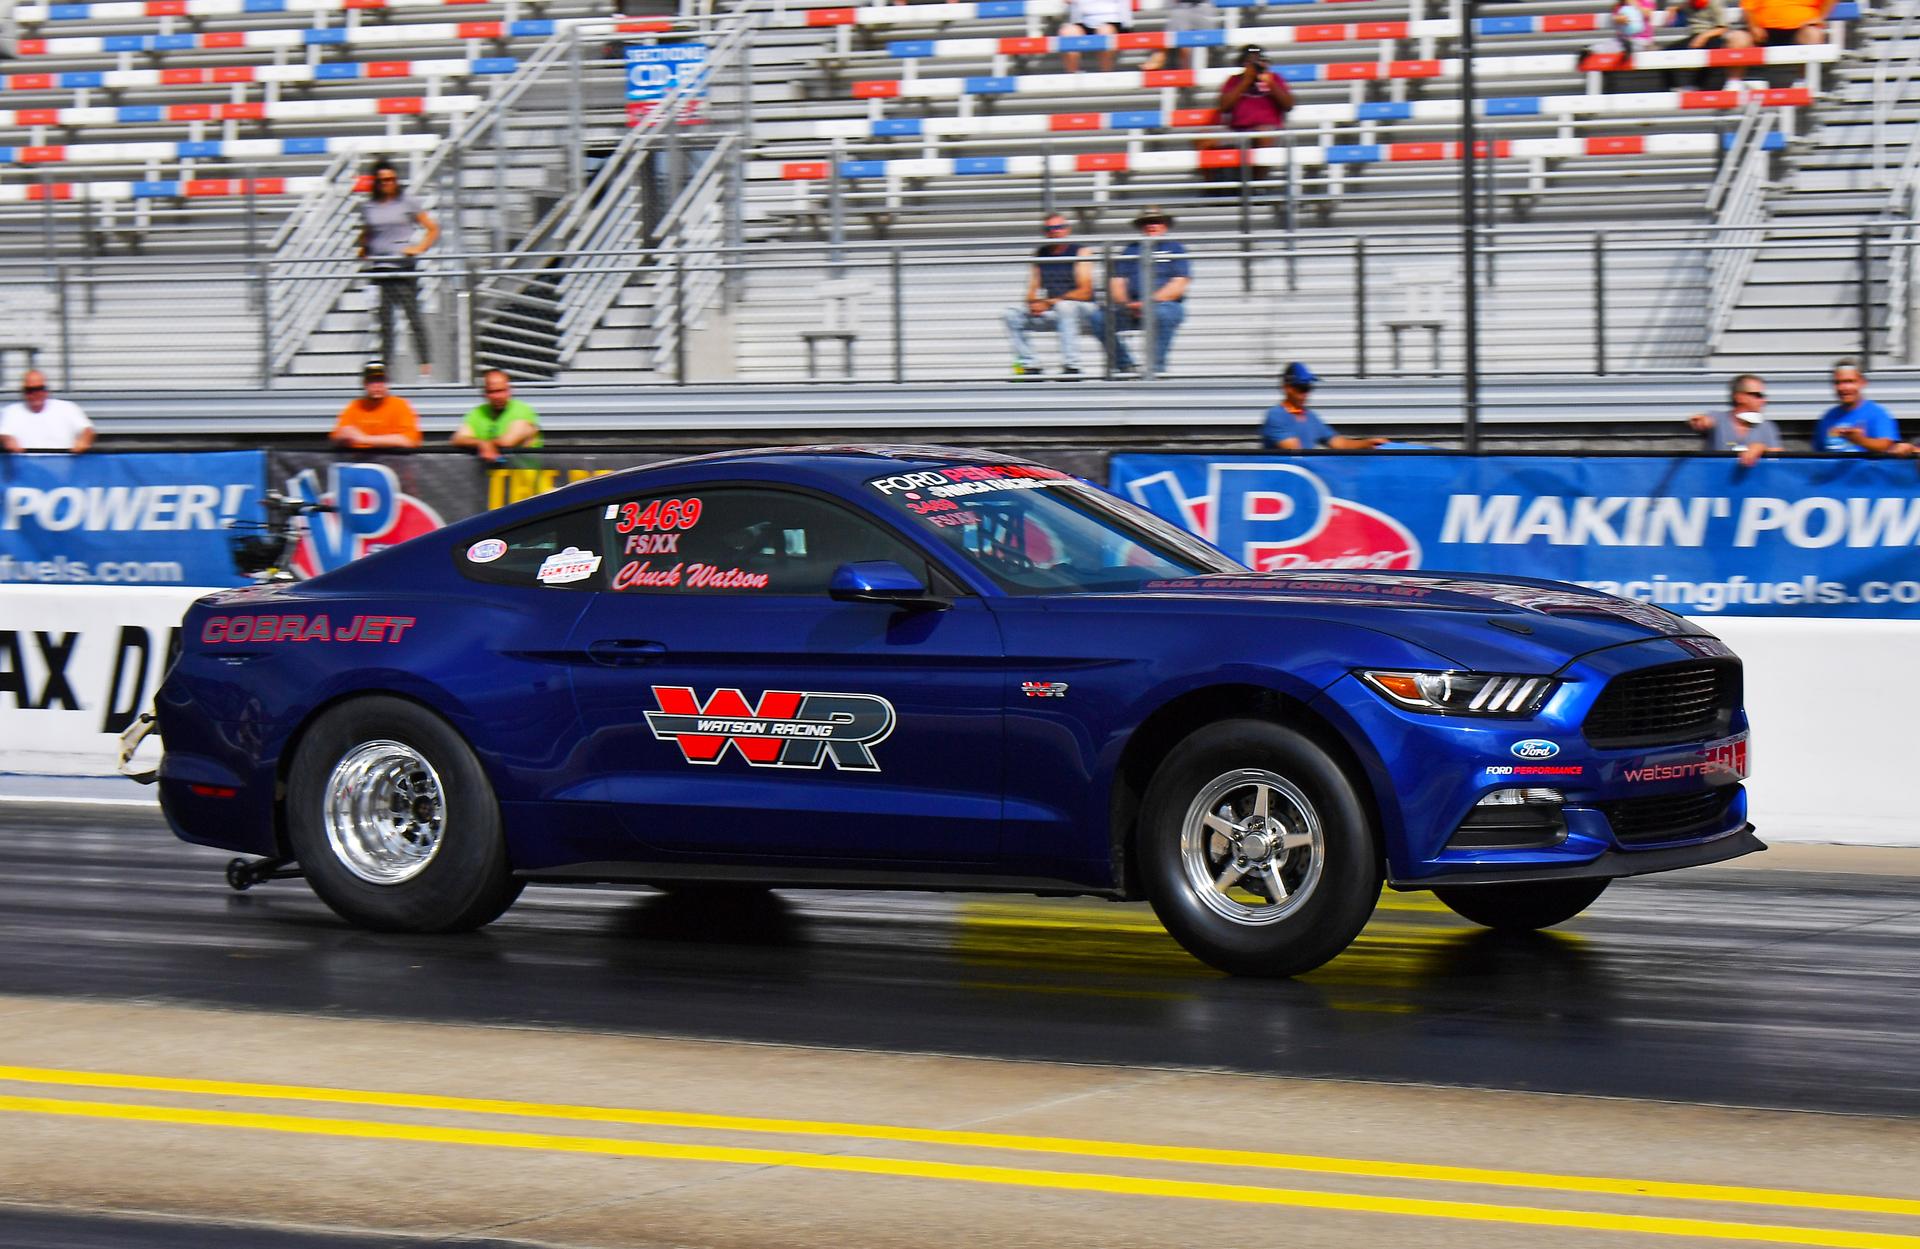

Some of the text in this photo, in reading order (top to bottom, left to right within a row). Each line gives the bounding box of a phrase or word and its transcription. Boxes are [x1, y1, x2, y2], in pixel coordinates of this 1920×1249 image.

[871, 471, 948, 496] FORD
[1, 484, 255, 531] POWER!
[615, 498, 702, 533] 3469
[1439, 494, 1730, 547] MAKIN'
[624, 533, 681, 555] FS/XX
[612, 560, 769, 591] Chuck Watson
[1572, 574, 1920, 611] acingfuels.co
[202, 614, 416, 643] COBRA JET
[643, 685, 897, 773] WR
[697, 720, 834, 737] WATSON RACING
[1520, 742, 1551, 756] Ford
[1486, 766, 1583, 775] FORD PERFORMANCE
